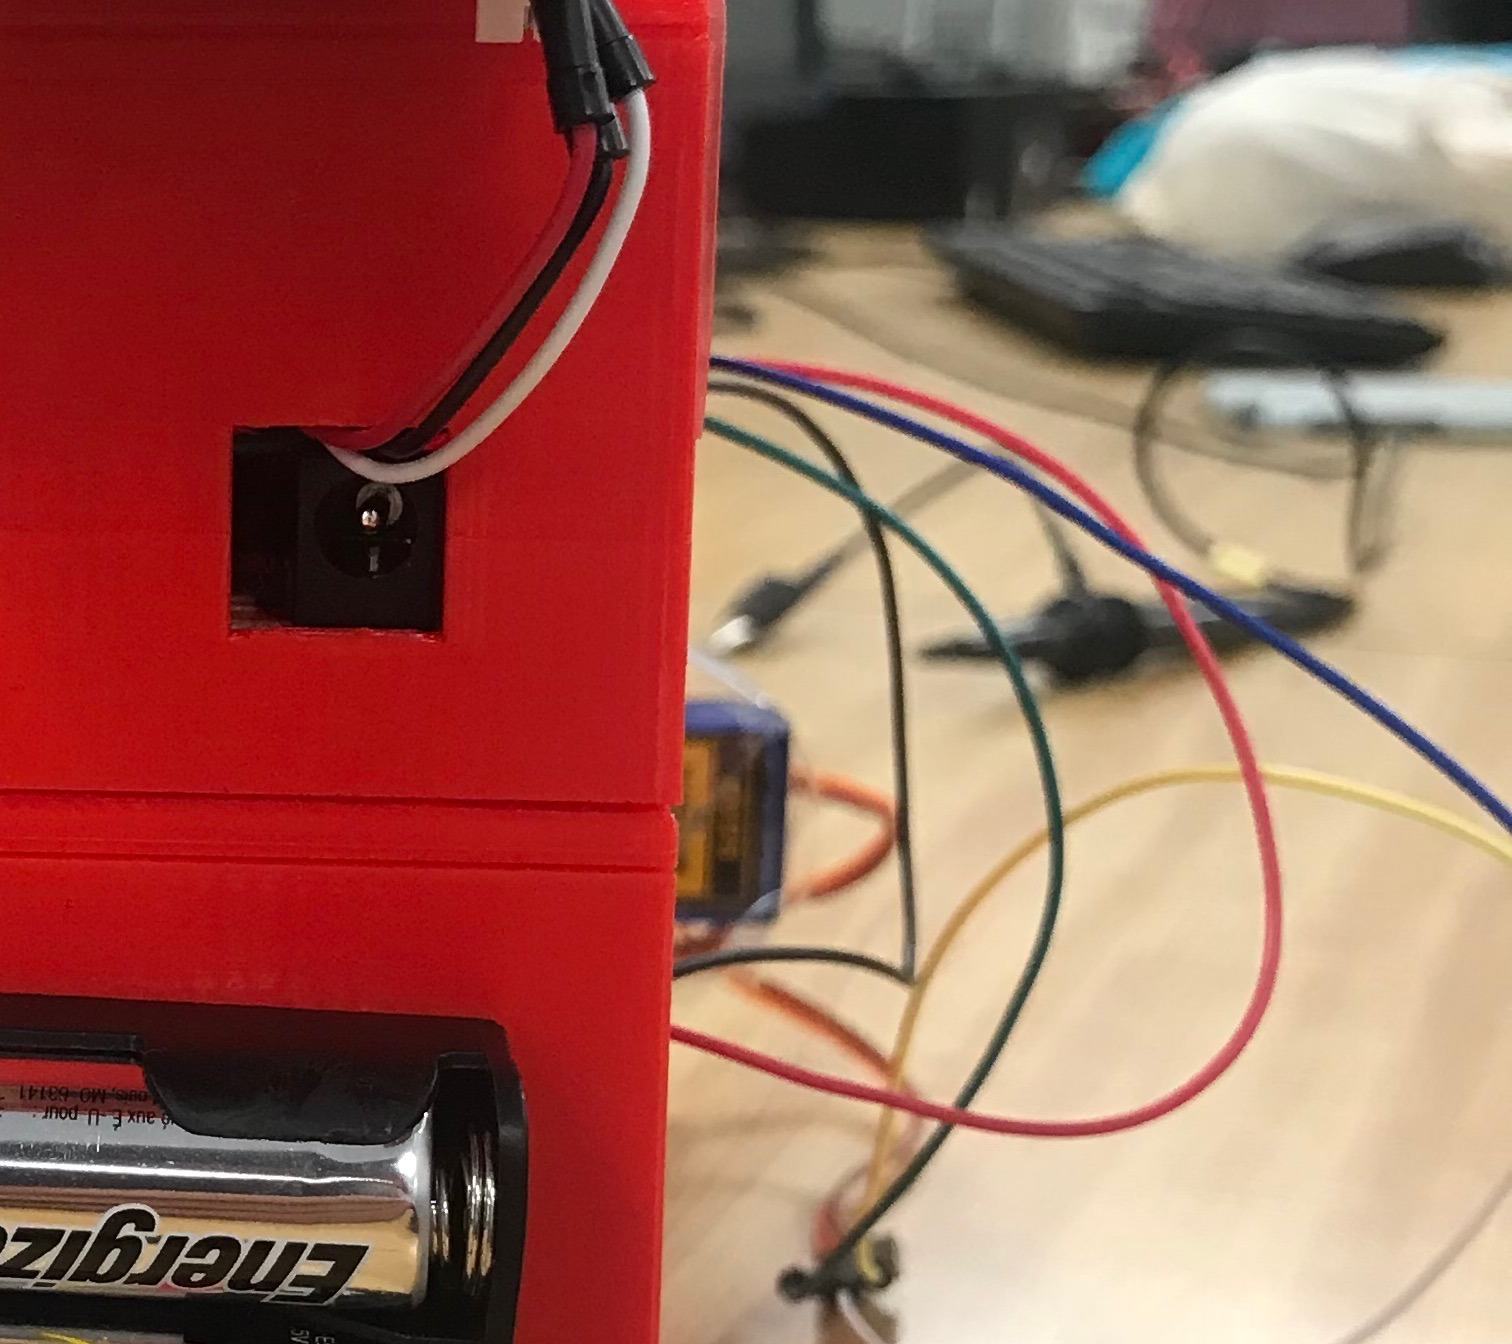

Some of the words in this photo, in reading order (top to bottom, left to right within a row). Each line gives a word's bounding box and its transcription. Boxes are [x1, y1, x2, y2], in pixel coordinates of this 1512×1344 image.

[19, 1084, 70, 1101] 63141
[41, 1105, 79, 1121] pour
[127, 1108, 156, 1125] aux
